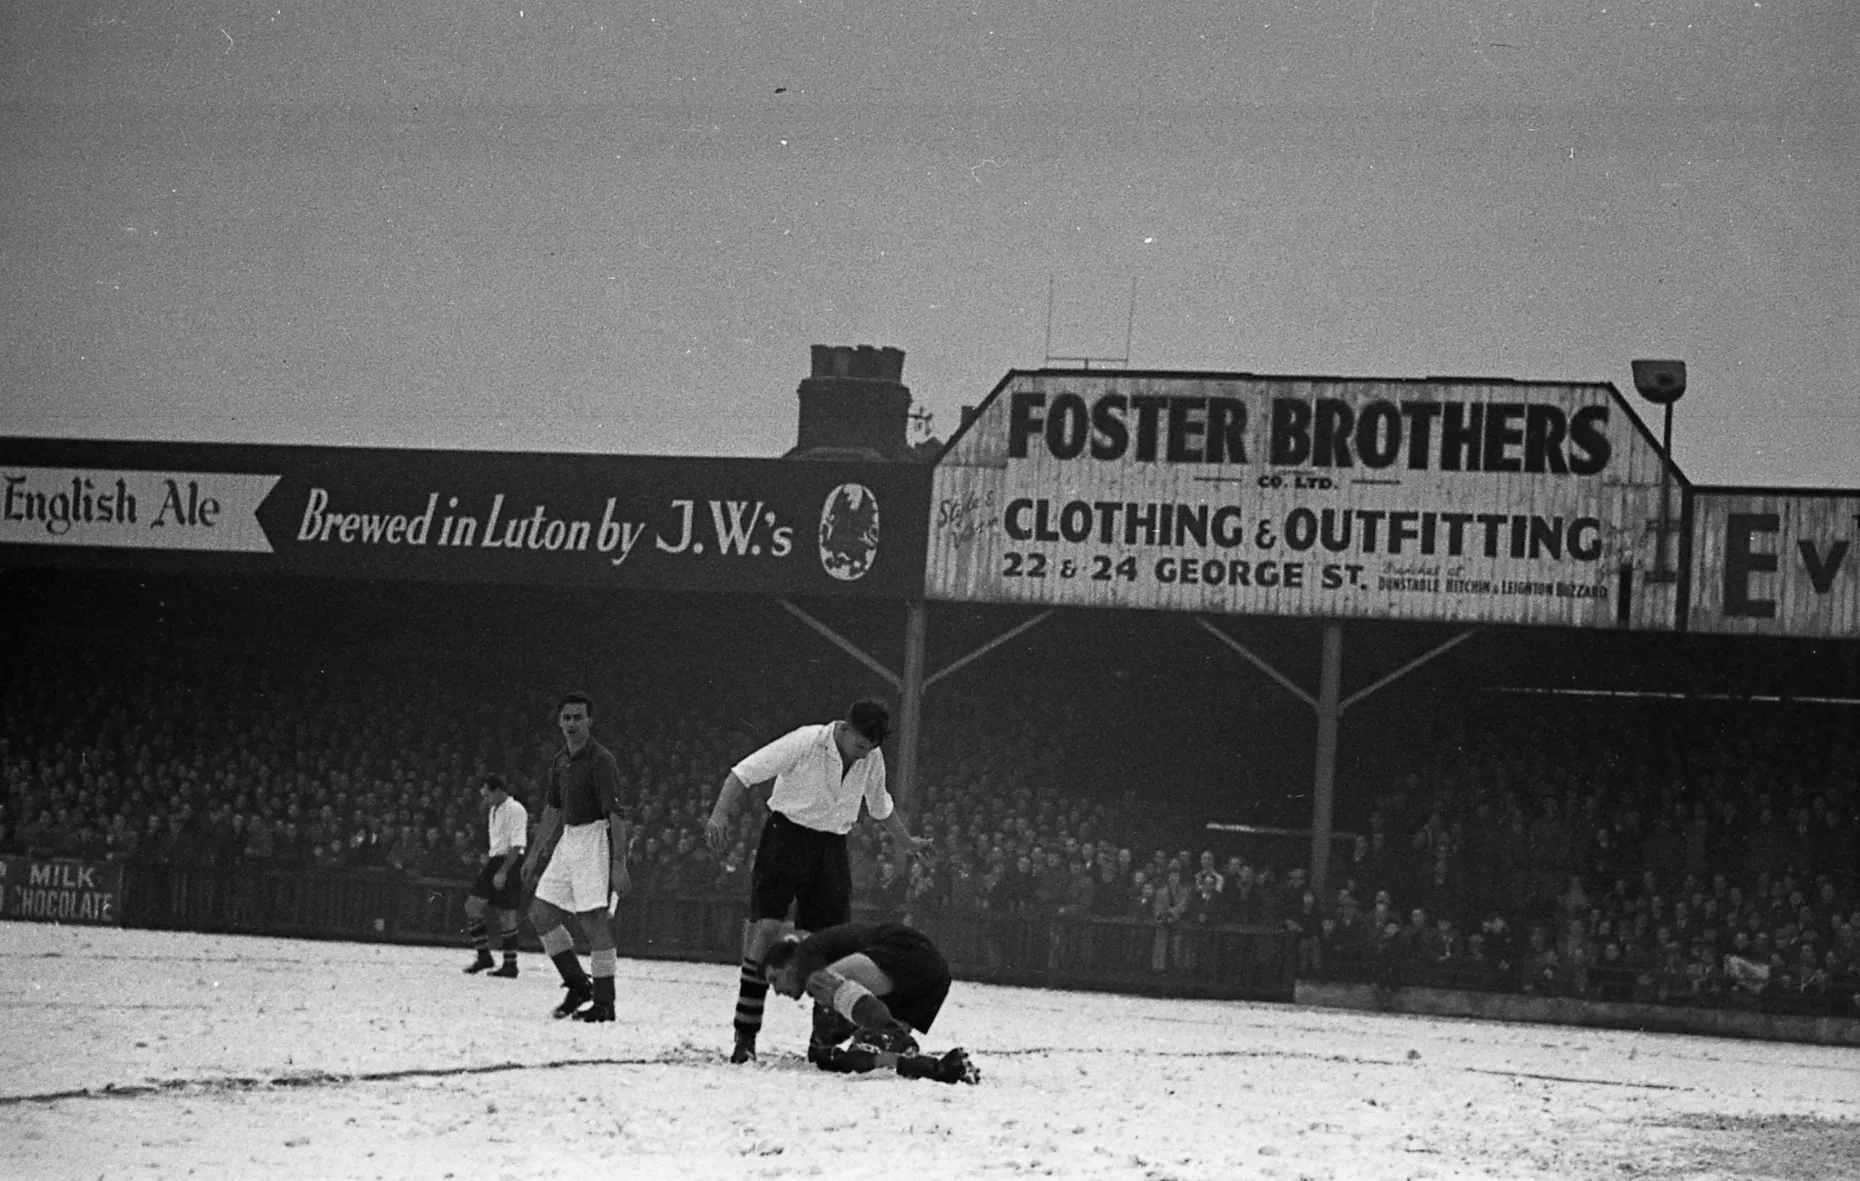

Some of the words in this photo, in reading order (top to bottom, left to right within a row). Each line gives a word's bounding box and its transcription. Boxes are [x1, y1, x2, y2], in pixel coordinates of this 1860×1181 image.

[1008, 392, 1249, 464] FOSTER
[1269, 397, 1612, 476] BROTHERS
[3, 476, 137, 535] English
[151, 478, 221, 528] Ale
[1257, 475, 1289, 489] CO.
[1294, 476, 1338, 490] LTD.
[297, 487, 440, 545] Brewed
[437, 496, 477, 547] in
[480, 494, 591, 551] Luton
[597, 497, 646, 566] by
[1003, 498, 1244, 548] CLOTHING
[1254, 519, 1278, 550] &
[1283, 507, 1602, 561] OUTFITTING
[1002, 552, 1047, 578] 22
[1060, 559, 1078, 578] &
[1091, 555, 1139, 581] 24
[1154, 557, 1304, 588] GEORGE
[1321, 563, 1368, 591] ST.
[1378, 575, 1440, 593] DUNSTABLE
[1501, 579, 1553, 596] LEIGHTON
[30, 863, 96, 889] MILK
